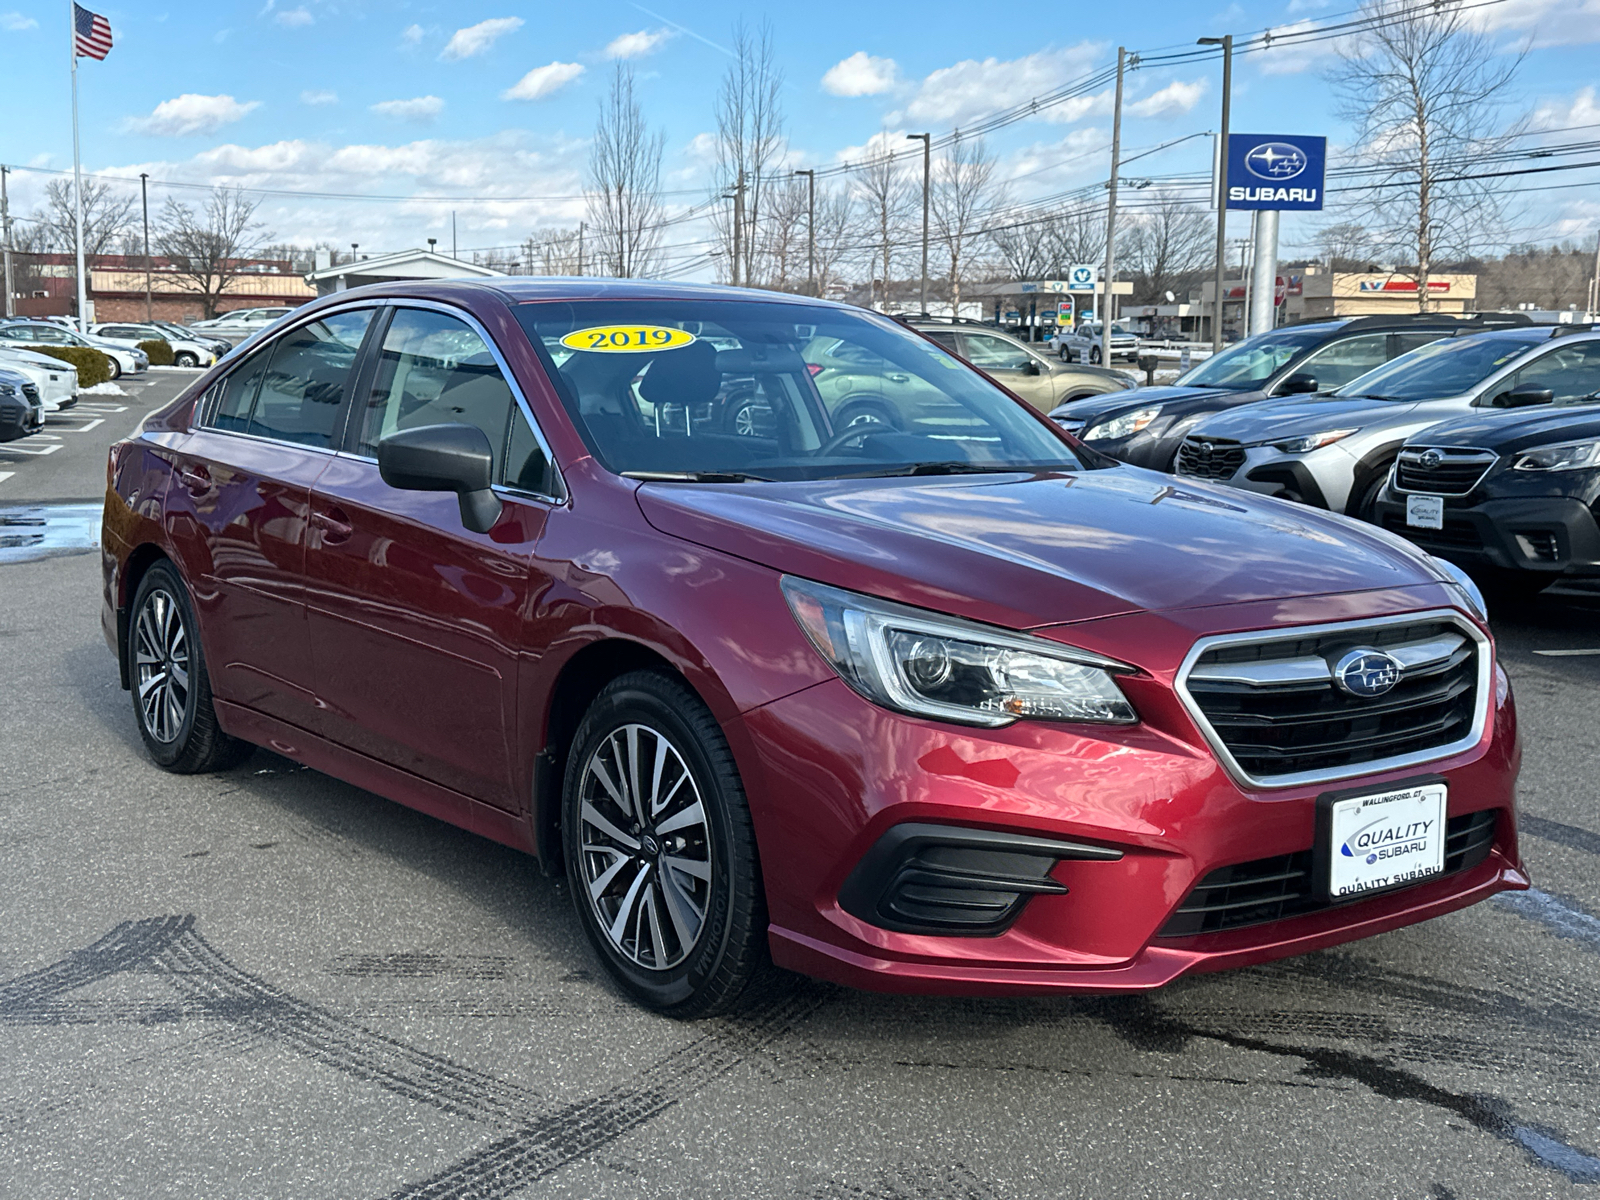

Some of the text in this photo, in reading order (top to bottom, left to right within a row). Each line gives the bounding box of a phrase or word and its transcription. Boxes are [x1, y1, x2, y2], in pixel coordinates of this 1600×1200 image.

[1229, 186, 1317, 202] SUBARU
[587, 330, 673, 349] 2019
[1413, 789, 1423, 798] CT
[1357, 819, 1434, 848] QUALITY
[1378, 840, 1427, 860] SUBARU
[1339, 865, 1441, 896] QUALITY SUBARU
